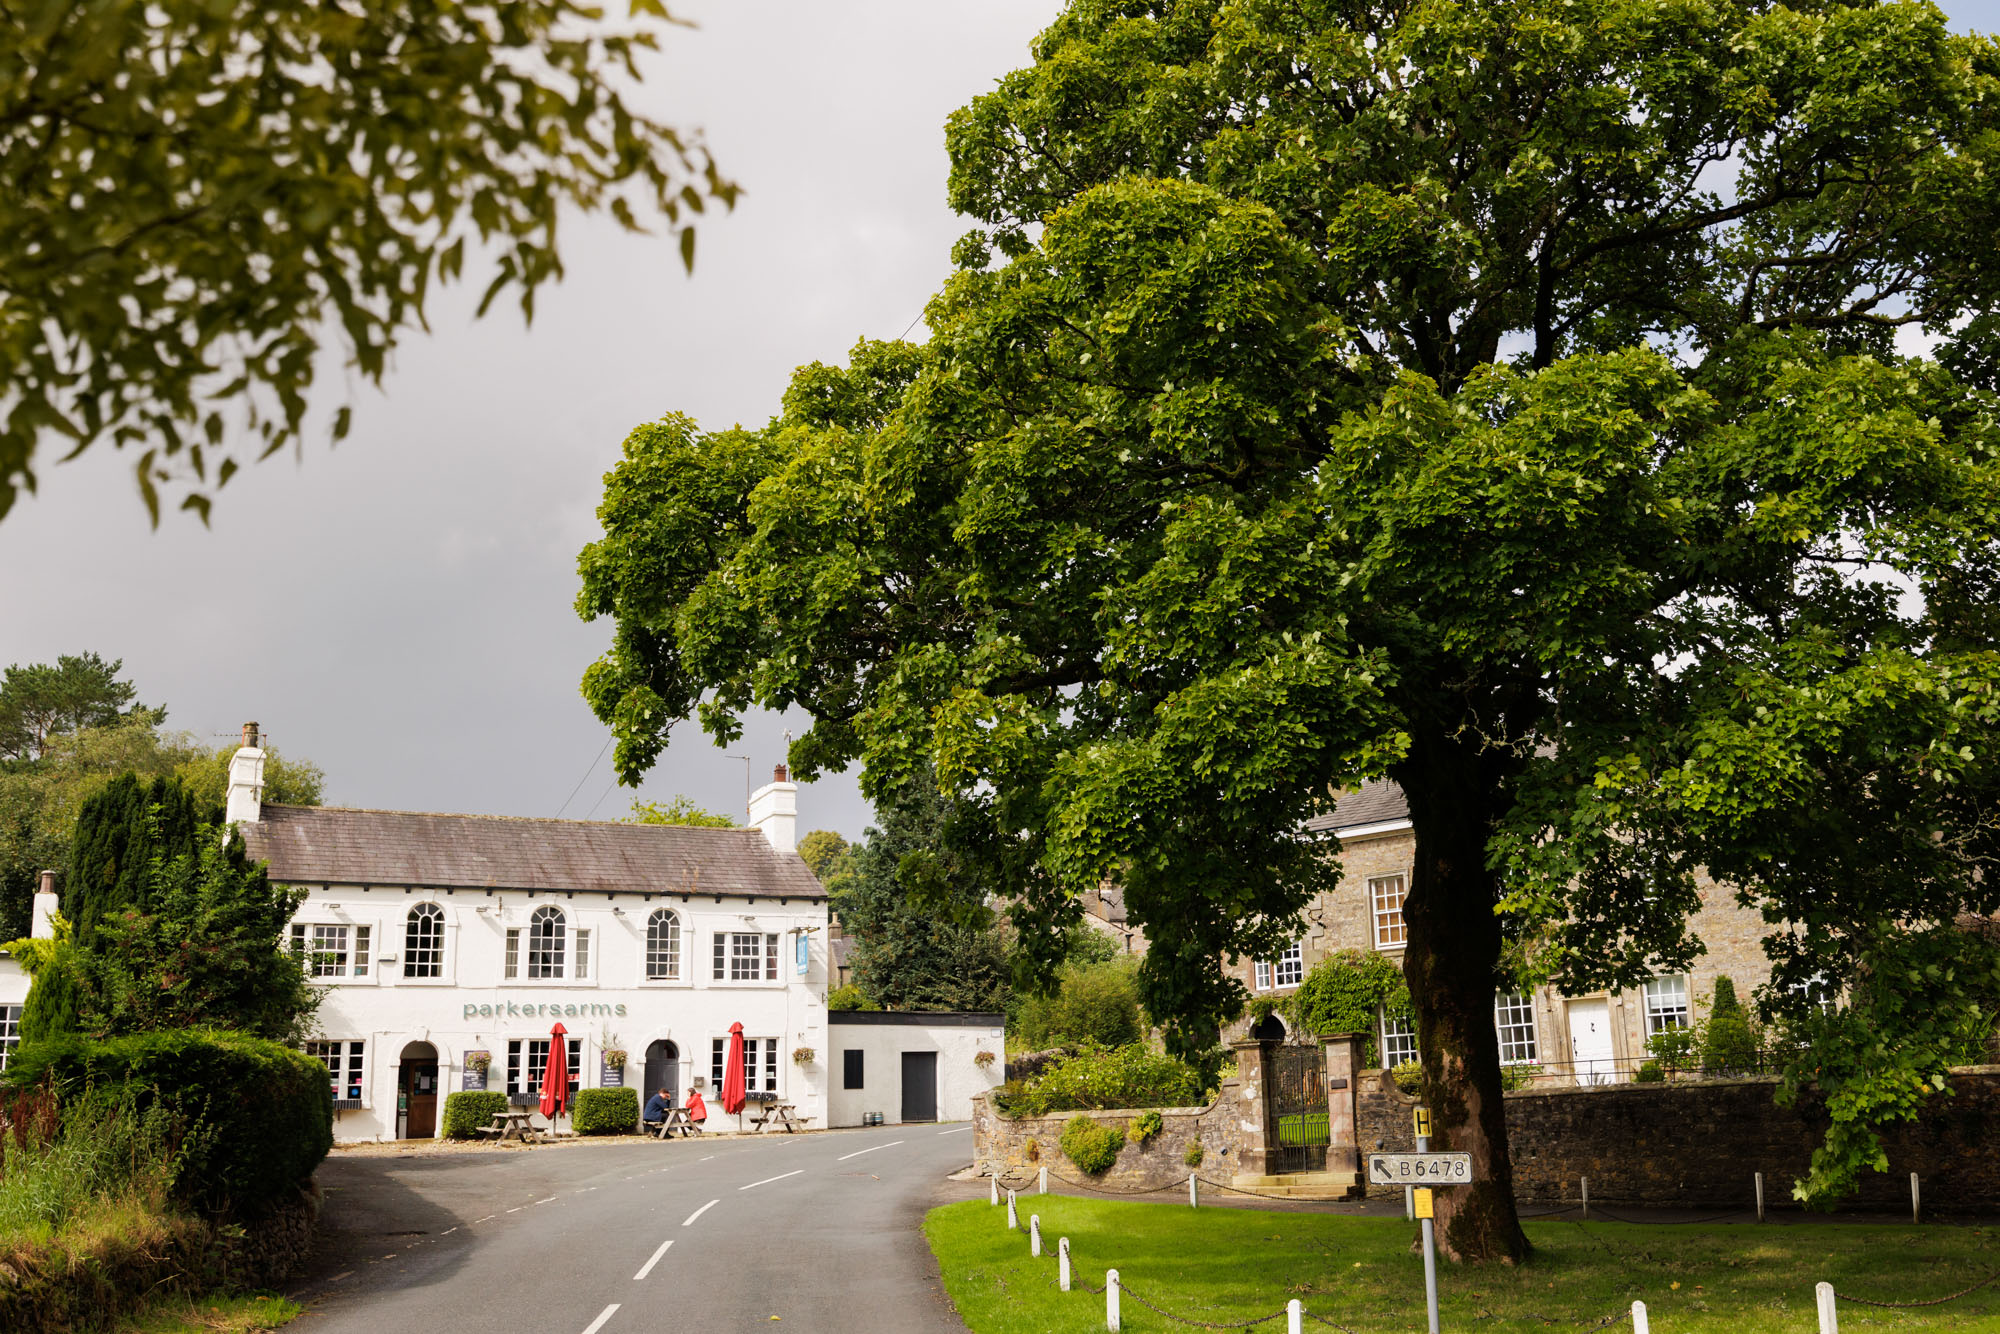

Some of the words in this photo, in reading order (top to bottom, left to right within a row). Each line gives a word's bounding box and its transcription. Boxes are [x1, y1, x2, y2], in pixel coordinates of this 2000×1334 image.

[463, 1000, 627, 1019] parkersarms
[1416, 1111, 1430, 1134] H
[1400, 1160, 1465, 1177] B6478
